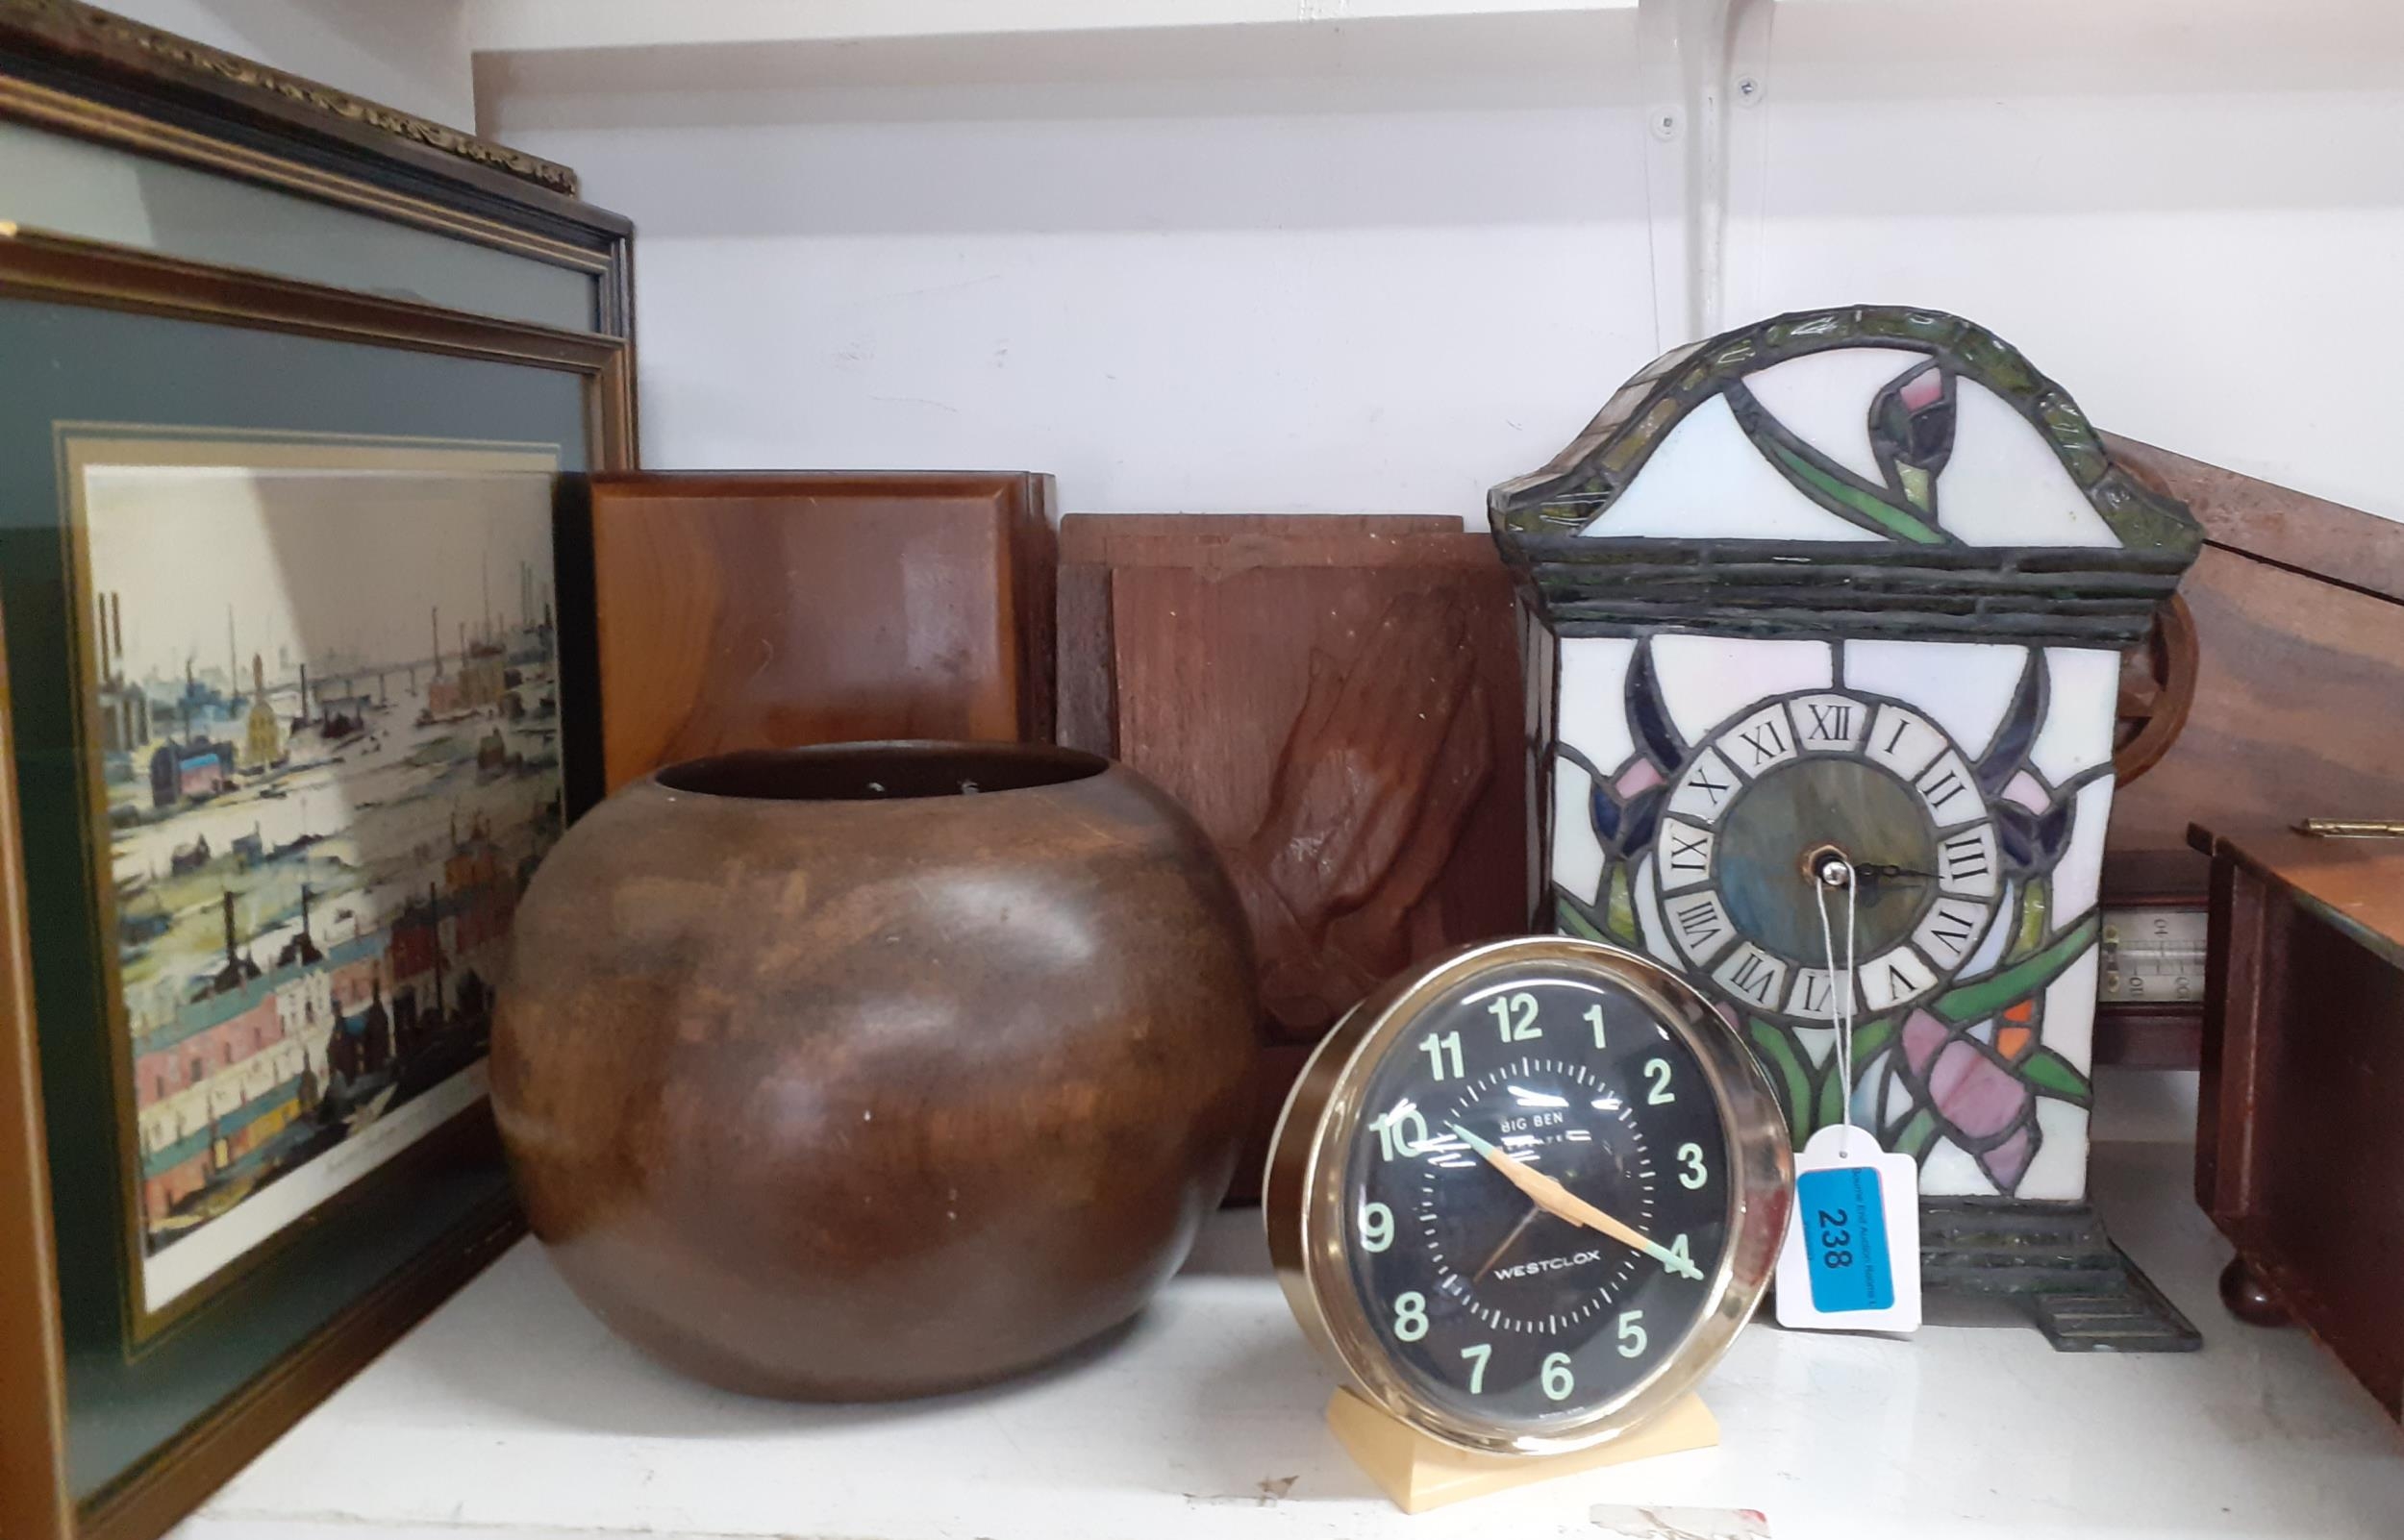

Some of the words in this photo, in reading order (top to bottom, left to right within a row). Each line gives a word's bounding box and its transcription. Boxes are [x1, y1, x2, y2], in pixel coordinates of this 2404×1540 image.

[1740, 720, 1787, 765] XI
[1808, 704, 1854, 741] XII
[1885, 719, 1911, 755] I
[1688, 767, 1729, 805] X
[1923, 770, 1966, 808] II
[1670, 835, 1709, 871] IX
[1945, 836, 1989, 882] III
[1678, 901, 1722, 949] VIII
[1930, 910, 1974, 956] IV
[1730, 953, 1777, 1004] VII
[1889, 964, 1917, 1000] V
[1488, 992, 1543, 1043] 12
[1583, 1005, 1607, 1049] 1
[1419, 1031, 1465, 1080] 11
[1643, 1058, 1675, 1105] 2
[1368, 1109, 1428, 1162] 10
[1500, 1116, 1528, 1133] BIG
[1533, 1111, 1565, 1128] BEN
[1676, 1142, 1708, 1190] 3
[1359, 1203, 1395, 1252] 9
[1817, 1208, 1854, 1270] 238
[1492, 1249, 1601, 1281] WESTCLOX
[1664, 1233, 1696, 1279] 4
[1394, 1291, 1430, 1342] 8
[1617, 1309, 1648, 1358] 5
[1461, 1343, 1492, 1395] 7
[1540, 1352, 1575, 1401] 6
